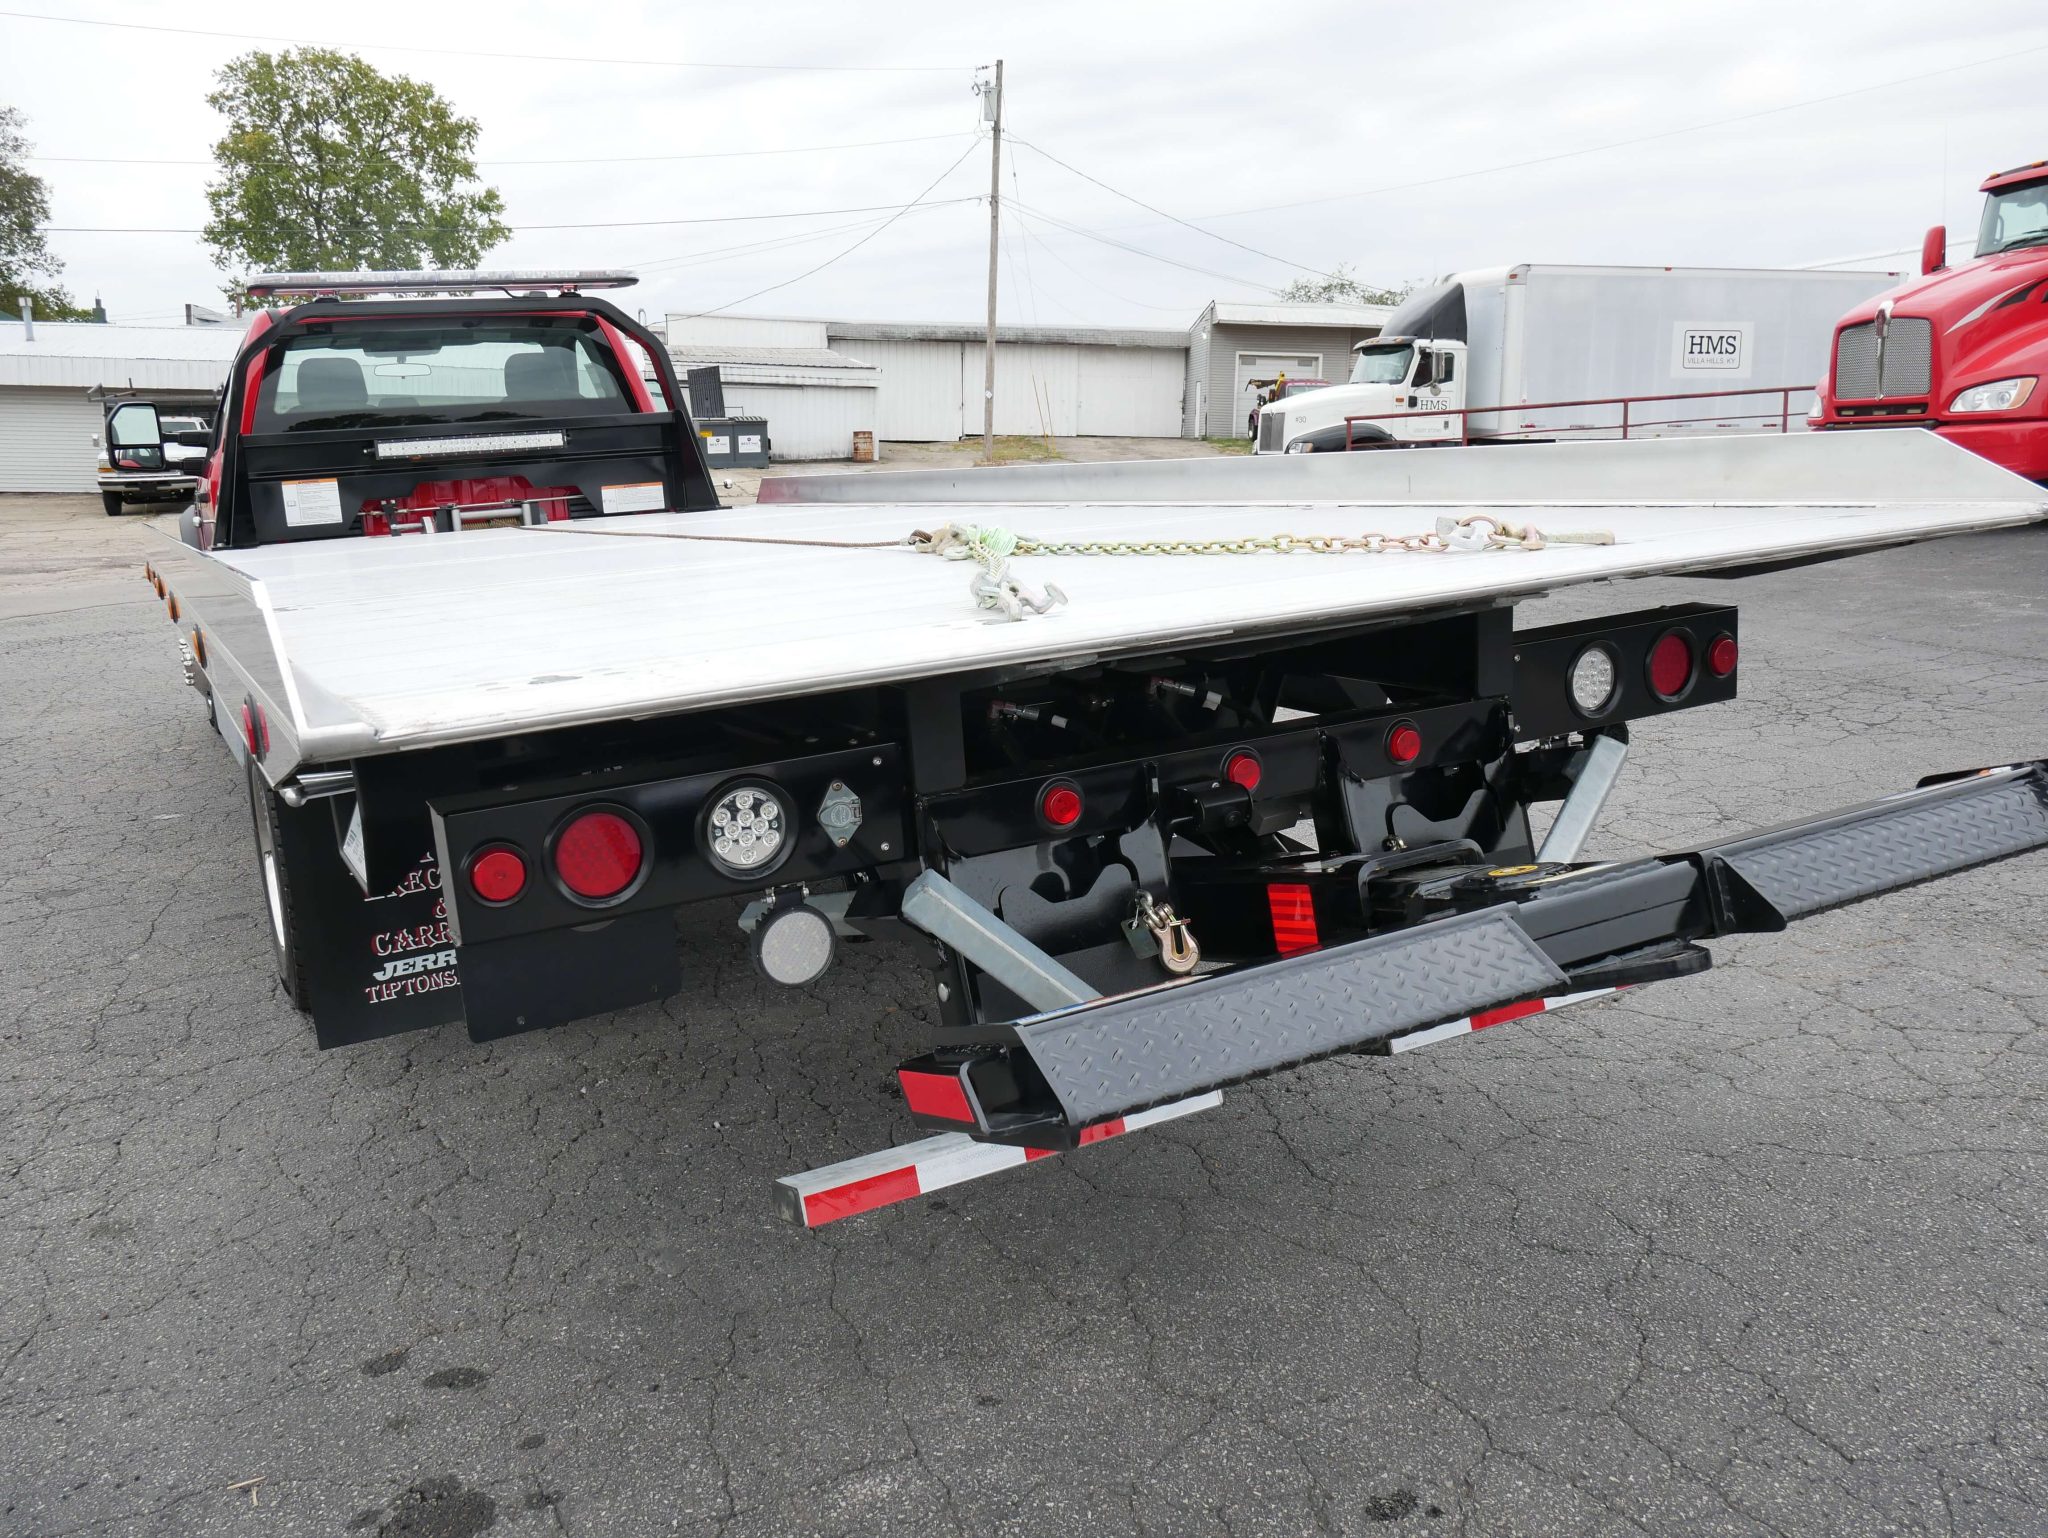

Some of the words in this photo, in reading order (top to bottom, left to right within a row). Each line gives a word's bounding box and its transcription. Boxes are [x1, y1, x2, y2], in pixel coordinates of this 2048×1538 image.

[1688, 335, 1737, 355] HMS
[1420, 399, 1448, 411] HMS
[373, 949, 457, 981] JERR
[365, 969, 461, 1003] TIPTONS
